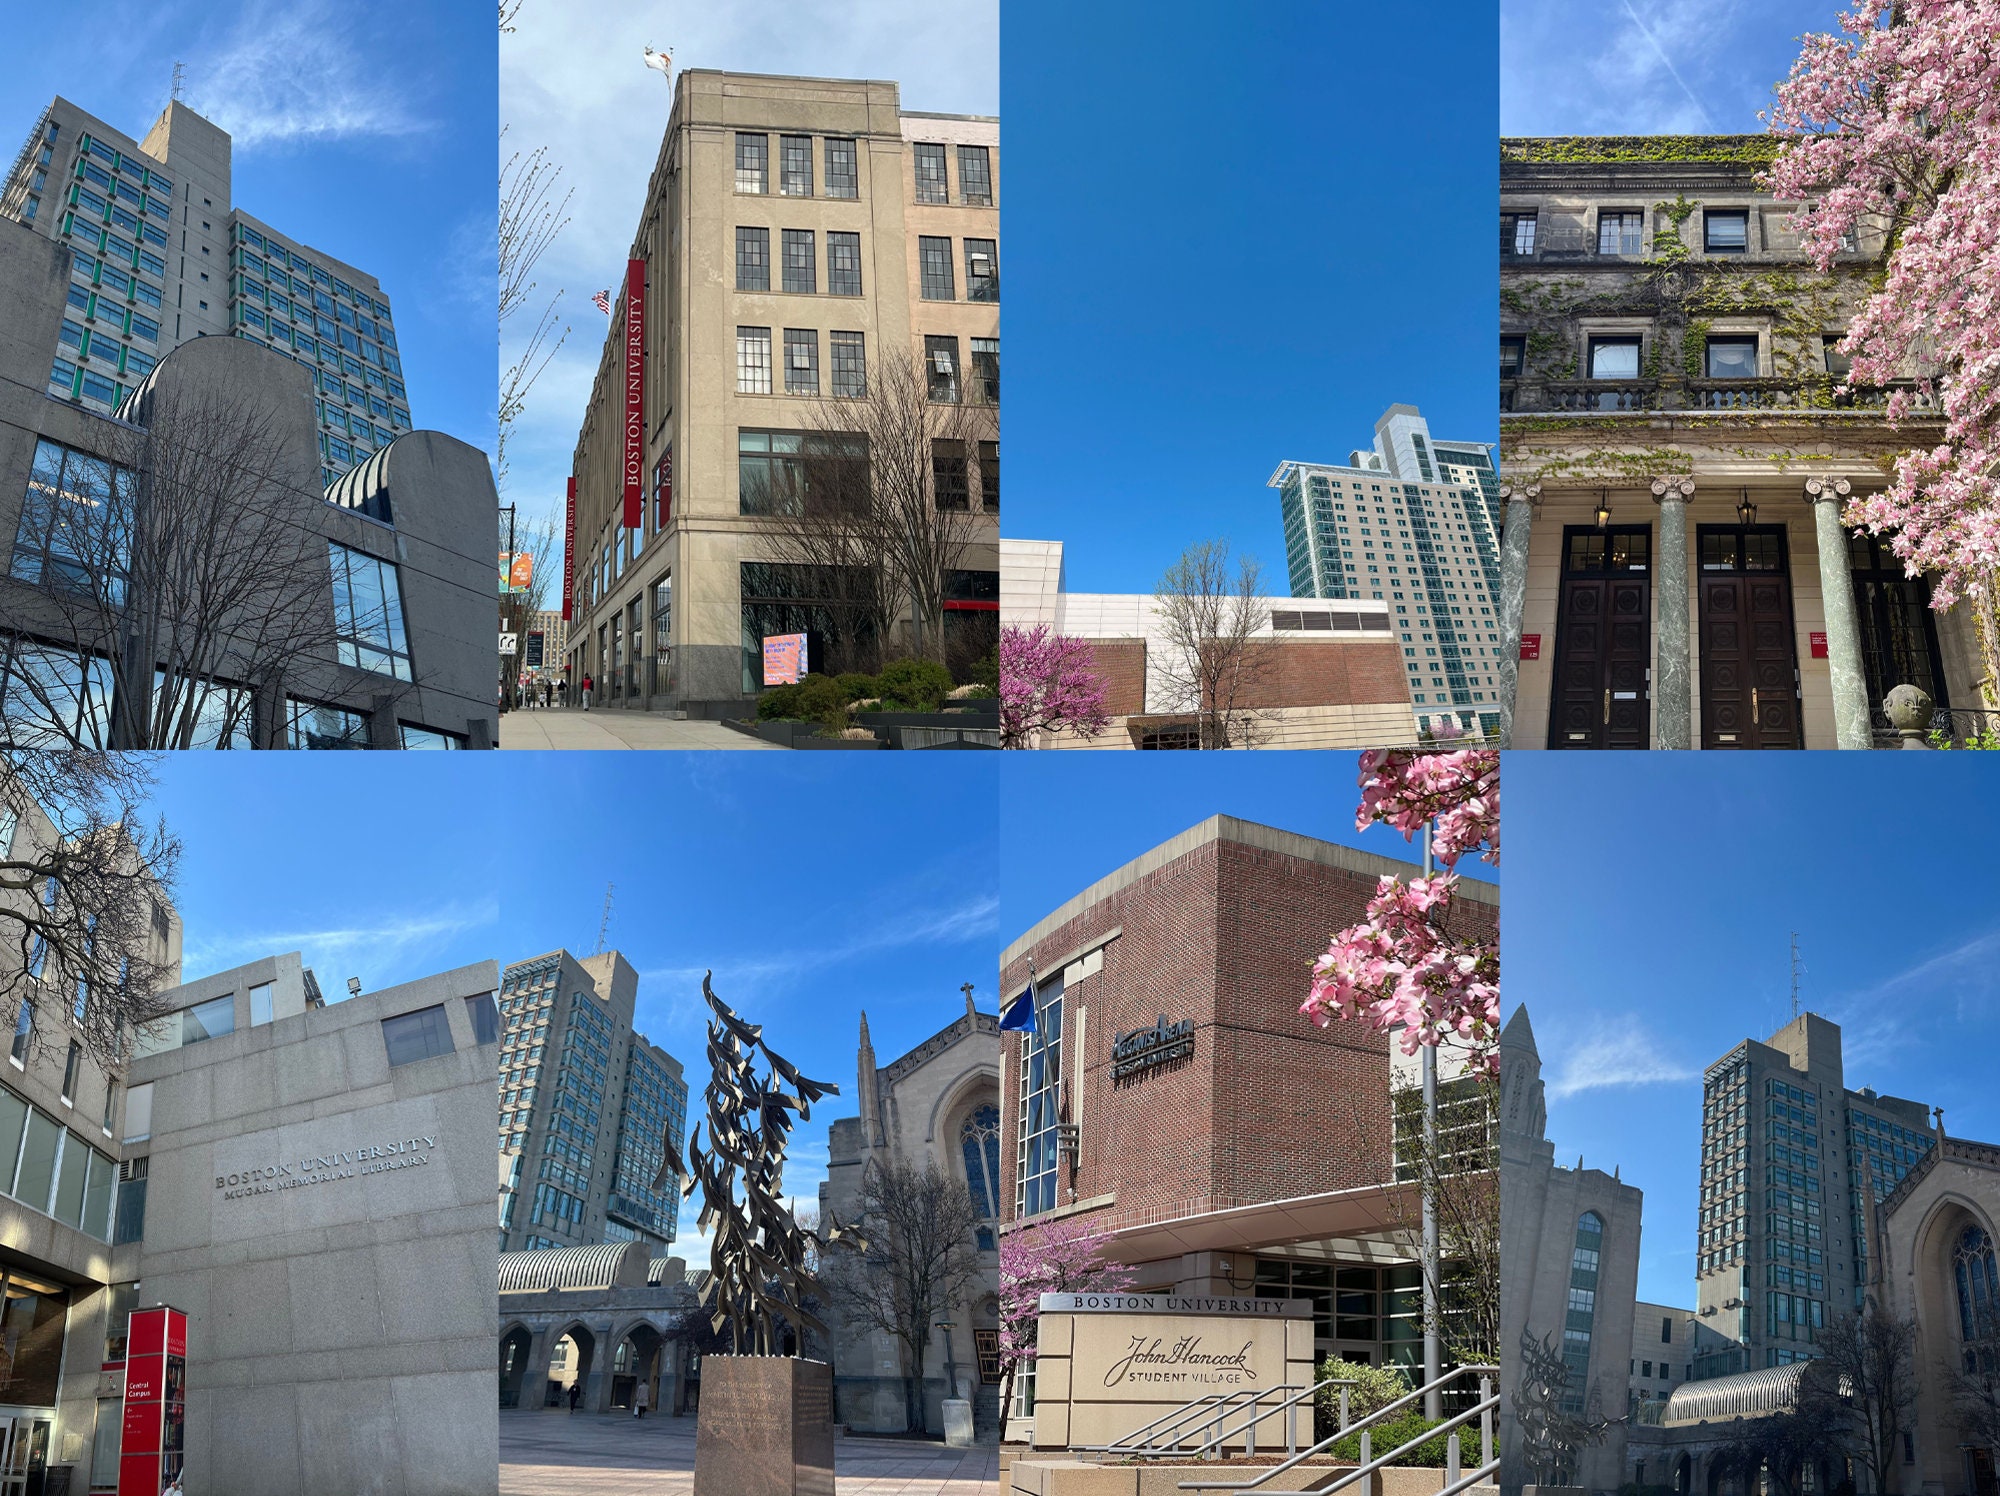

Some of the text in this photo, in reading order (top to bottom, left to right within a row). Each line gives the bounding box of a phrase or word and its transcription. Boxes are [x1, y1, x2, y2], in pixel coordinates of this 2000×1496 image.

[627, 296, 642, 486] BOSTON UNIVERSITY
[564, 497, 575, 599] BOSTON UNIVERSITY
[215, 1135, 437, 1189] BOSTON UNIVERSITY
[224, 1154, 430, 1201] MUGAR MEMORIAL LIBRARY
[1074, 1296, 1285, 1313] BOSTON UNIVERSITY
[1104, 1335, 1257, 1387] John Hancock
[1129, 1372, 1241, 1384] STUDENT VILLAGE
[128, 1390, 151, 1398] Campus
[129, 1381, 149, 1389] Central
